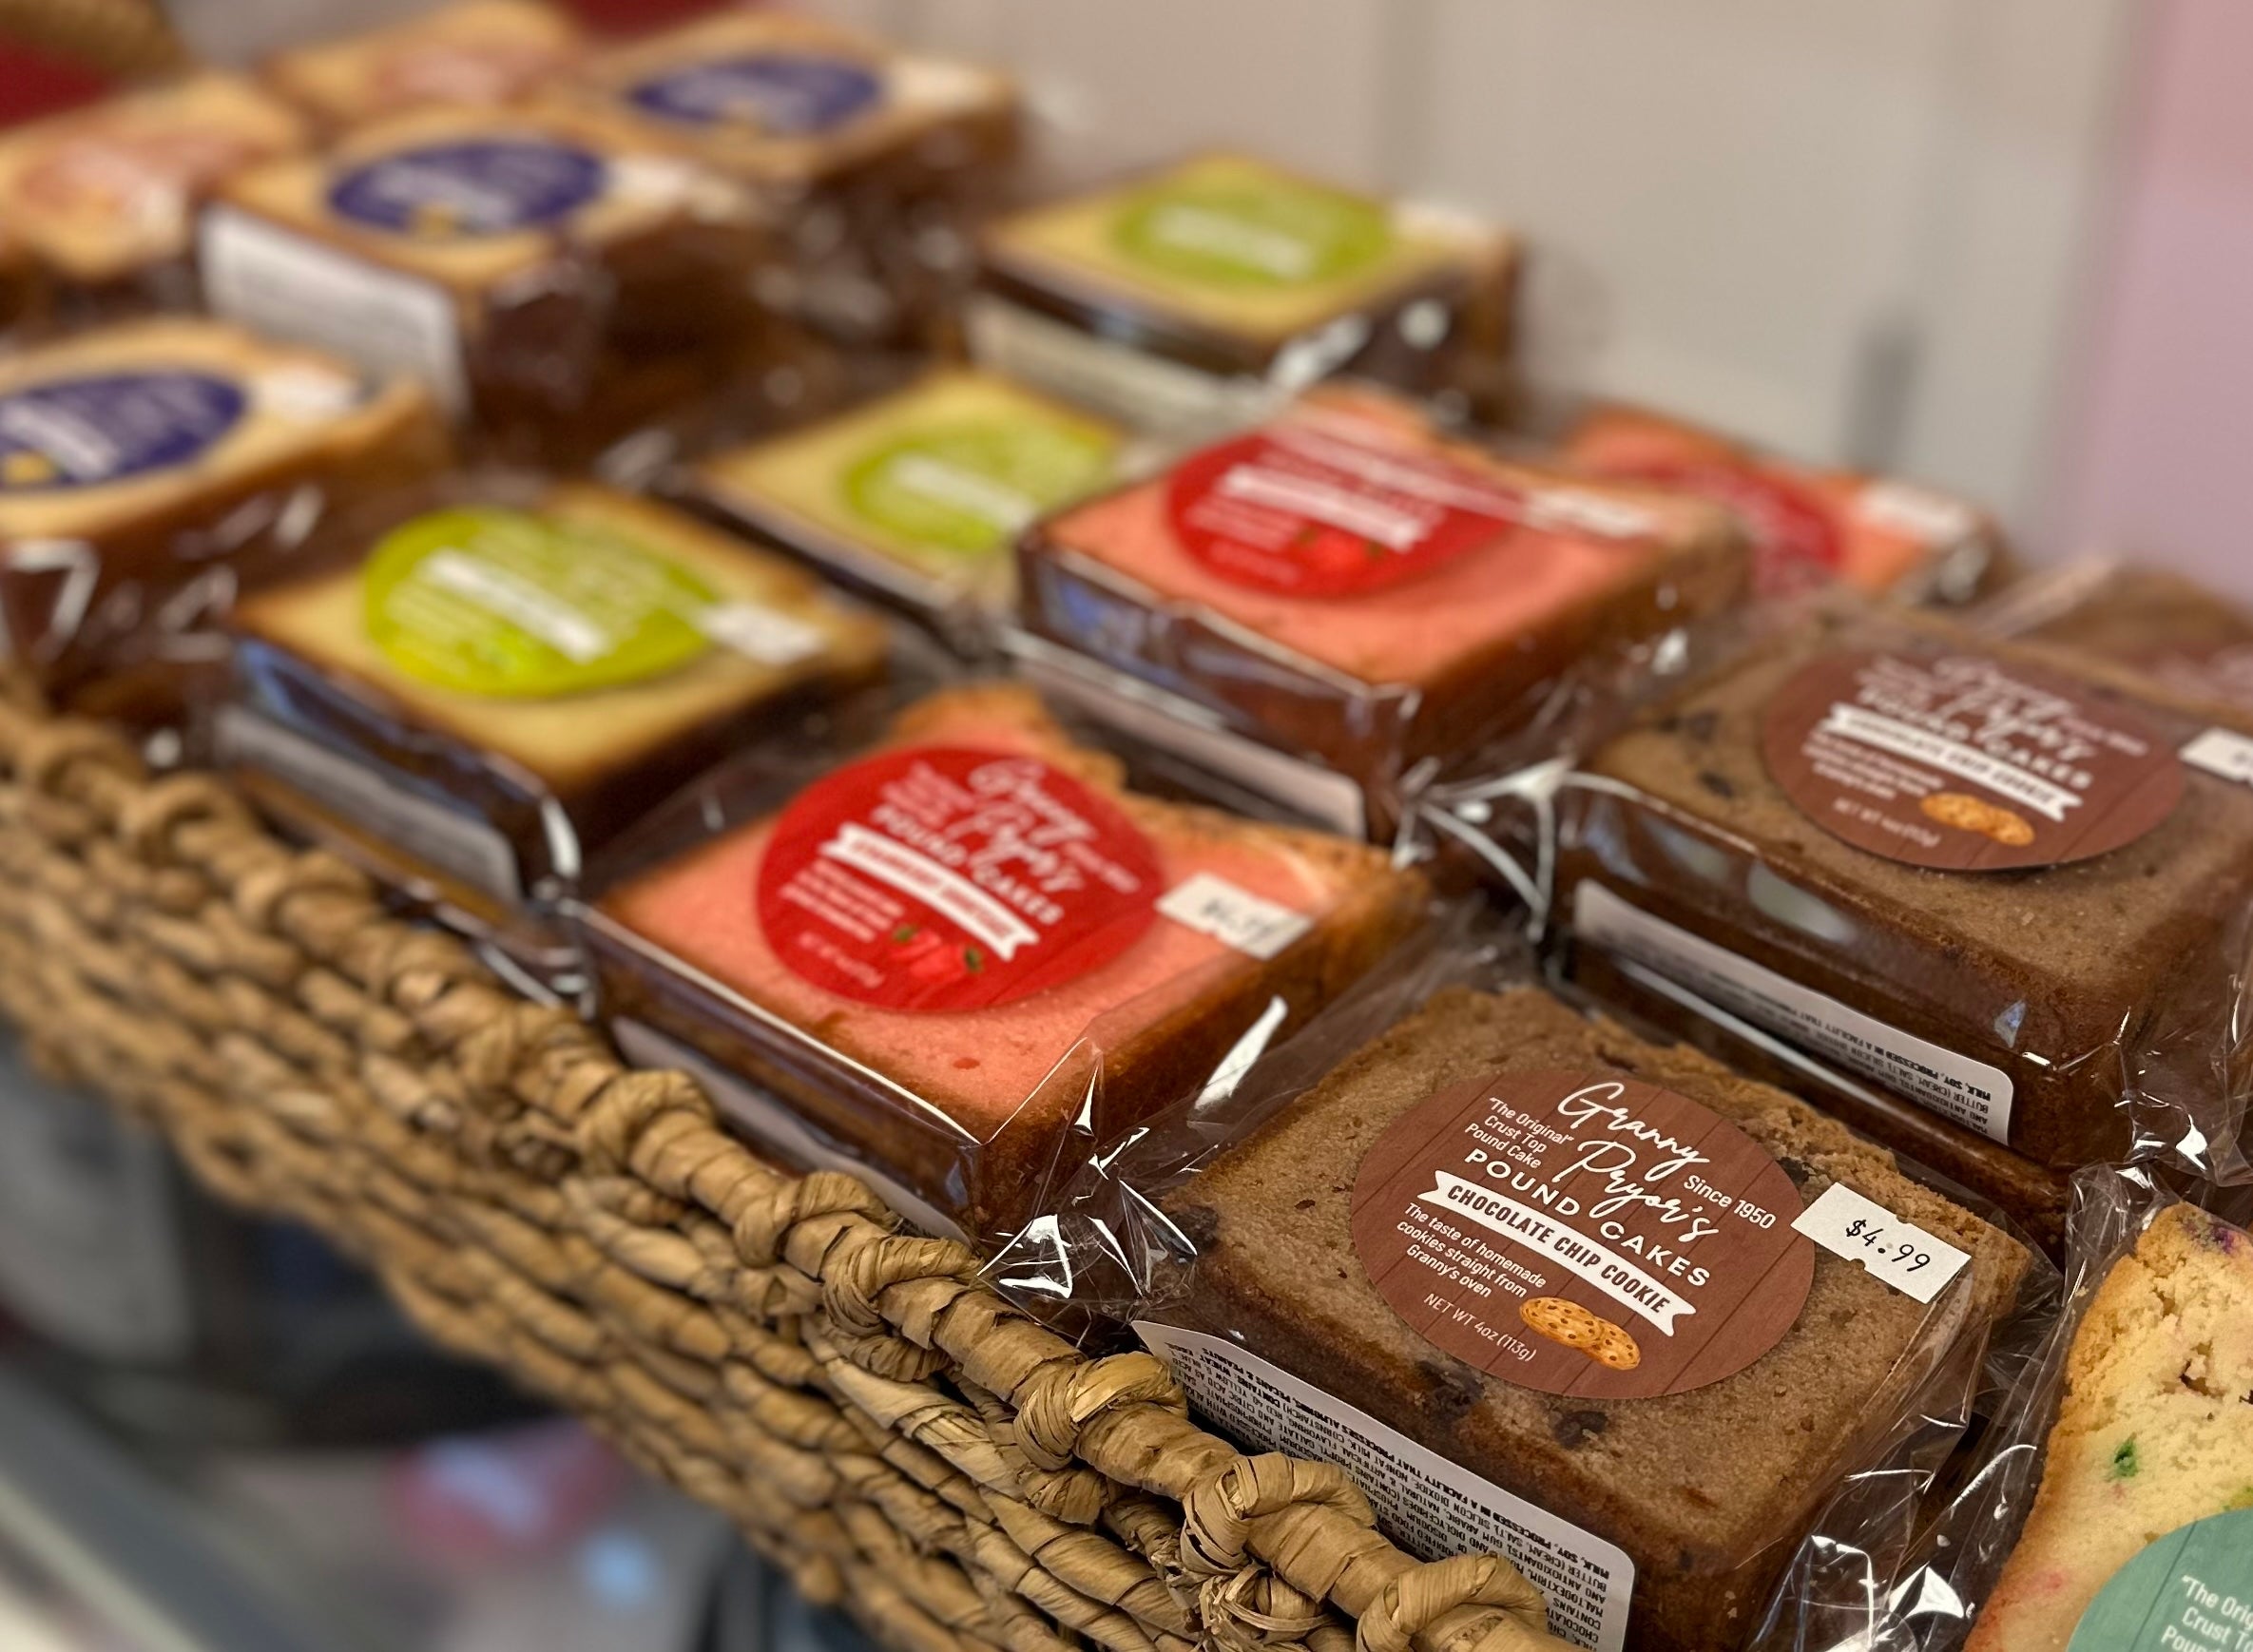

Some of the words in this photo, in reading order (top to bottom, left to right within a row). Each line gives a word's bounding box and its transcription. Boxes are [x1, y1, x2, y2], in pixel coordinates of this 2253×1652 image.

[1465, 1123, 1510, 1151] Pound
[1507, 1144, 1542, 1169] Cake
[1484, 1115, 1521, 1140] Crust
[1521, 1133, 1547, 1154] Top
[1557, 1082, 1710, 1181] Granny
[1465, 1148, 1581, 1216] POUND
[1600, 1220, 1710, 1286] CAKES
[1551, 1141, 1719, 1241] Pryor's
[1684, 1175, 1733, 1208] Since
[1733, 1200, 1776, 1229] 1950
[1396, 1220, 1446, 1252] cookies
[1444, 1247, 1496, 1280] straight
[1493, 1274, 1528, 1297] from
[1404, 1202, 1429, 1223] The
[1428, 1217, 1462, 1240] taste
[1460, 1237, 1480, 1250] of
[1475, 1242, 1547, 1288] homemade
[1407, 1243, 1461, 1280] Granny's
[1458, 1276, 1492, 1298] oven
[1447, 1184, 1555, 1244] CHOCOLATE
[1553, 1237, 1602, 1268] CHIP
[1601, 1264, 1670, 1315] COOKIE
[1845, 1219, 1931, 1272] $4.99
[1423, 1293, 1454, 1314] NET
[1452, 1308, 1477, 1326] WT
[1474, 1321, 1499, 1341] 4oz
[1496, 1334, 1537, 1361] (113g)
[1396, 1456, 1421, 1479] THAT
[1423, 1471, 1468, 1506] FACILITY
[1469, 1534, 1488, 1555] AND
[1482, 1529, 1503, 1549] GUM
[1567, 1564, 1607, 1594] BUTTER
[1584, 1585, 1606, 1605] AND
[2182, 1606, 2231, 1645] Crust
